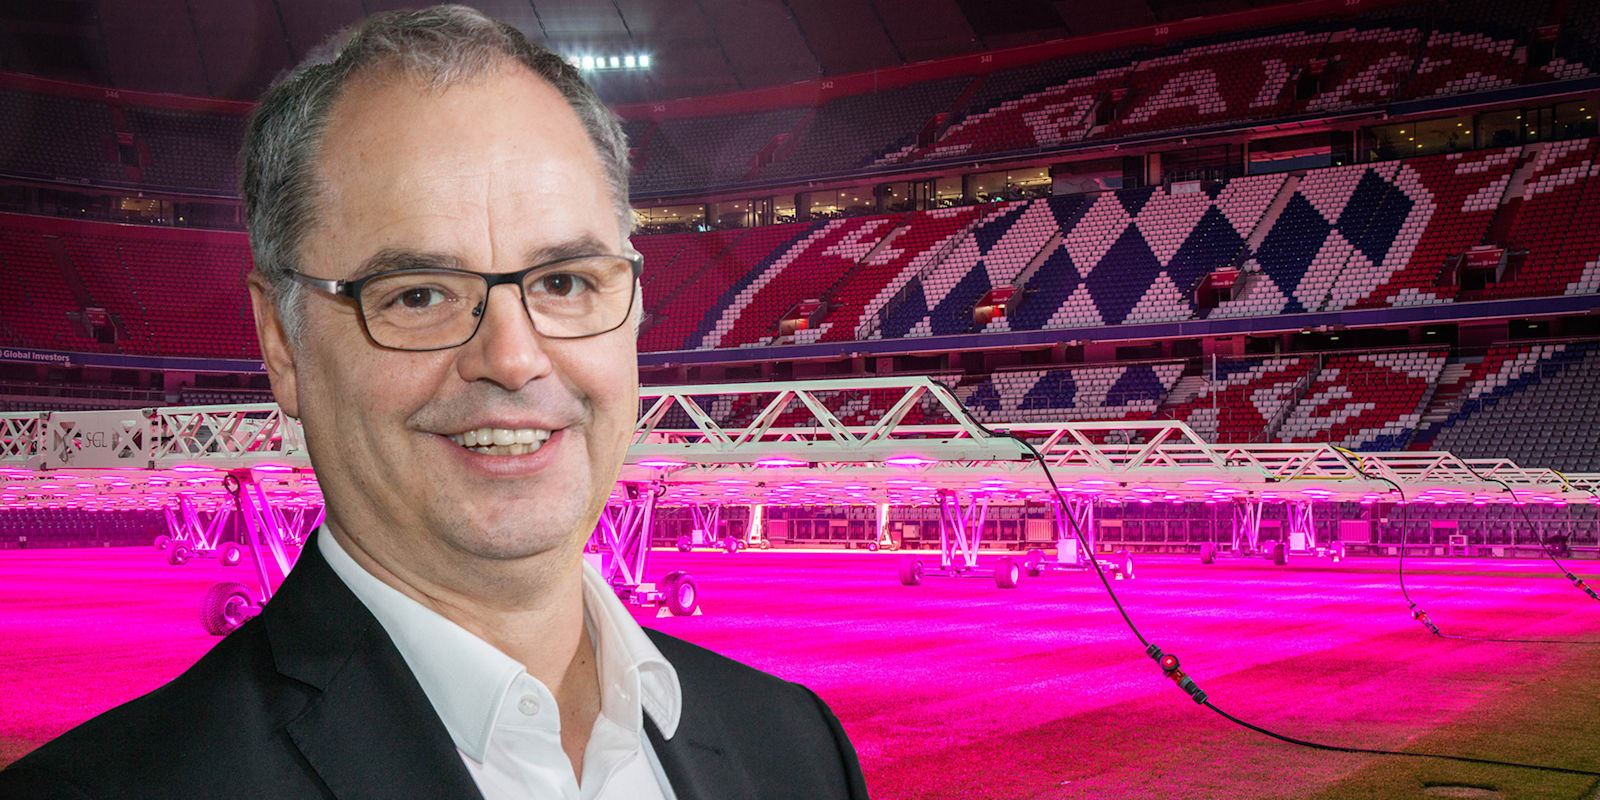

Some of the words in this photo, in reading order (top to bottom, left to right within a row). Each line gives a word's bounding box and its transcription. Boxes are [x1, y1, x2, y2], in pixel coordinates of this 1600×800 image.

[1154, 27, 1169, 36] 340
[980, 55, 993, 64] 341
[3, 350, 31, 360] Global
[32, 352, 71, 362] Investors
[85, 431, 108, 448] SGL
